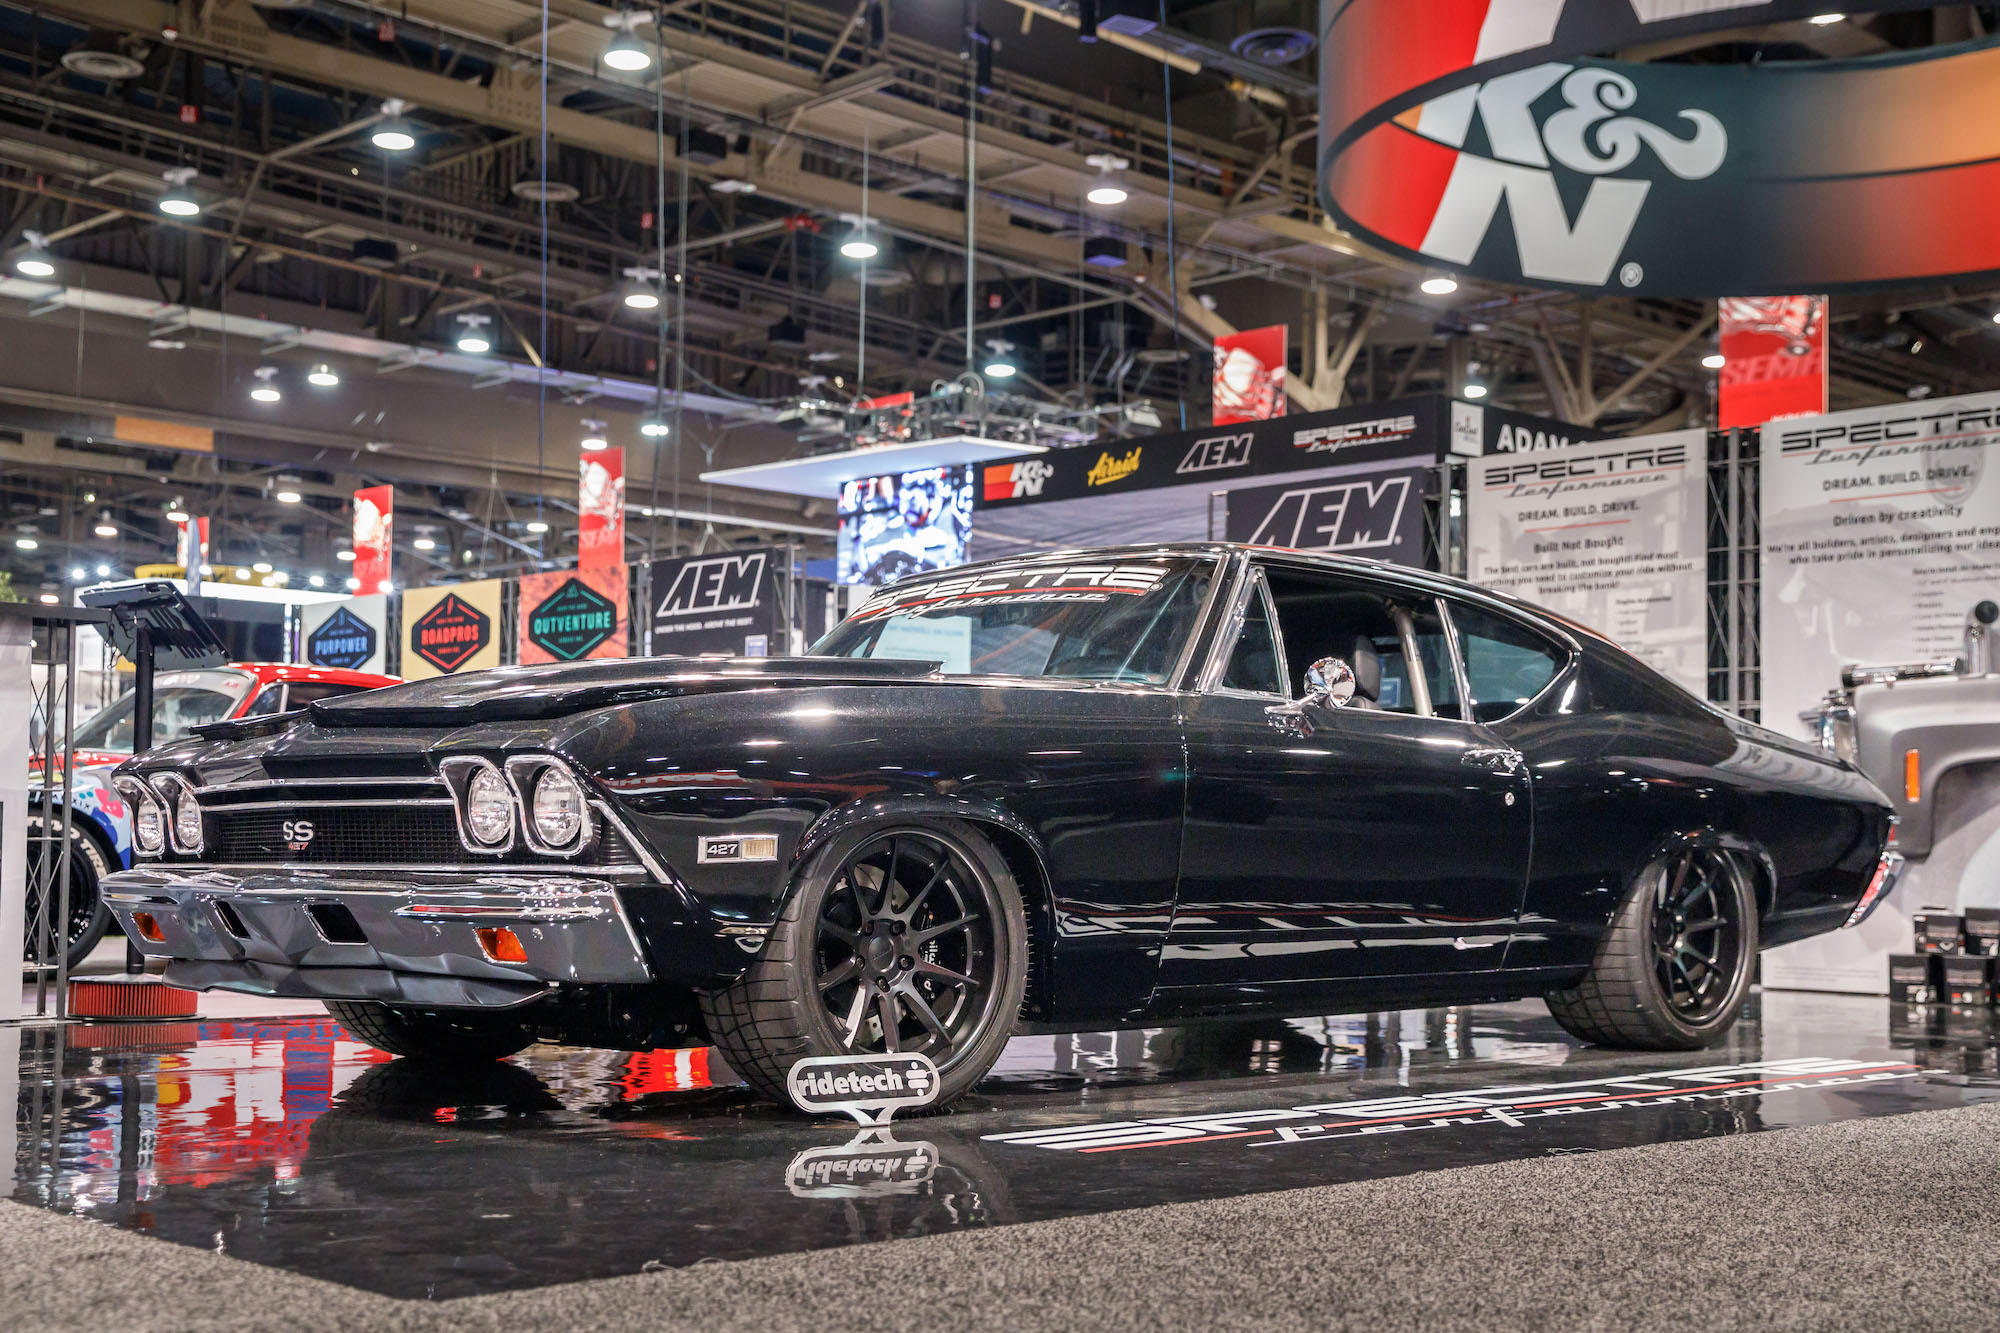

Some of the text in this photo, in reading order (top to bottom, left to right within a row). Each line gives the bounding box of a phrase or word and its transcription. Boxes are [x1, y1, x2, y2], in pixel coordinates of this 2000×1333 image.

[1293, 414, 1415, 446] SPECTRE
[1781, 405, 2000, 452] SPECTR
[1176, 432, 1255, 474] AEM
[1484, 445, 1686, 486] SPECTRE
[1823, 464, 1976, 492] DREAM. BUILD. DRIVE.
[1248, 476, 1412, 553] AEM
[1518, 499, 1641, 523] DREAM. BUILD. DRIVE.
[1833, 503, 1964, 527] Driven by creativity
[1533, 541, 1560, 554] Built
[1584, 536, 1624, 549] Bought
[655, 553, 767, 617] AEM
[858, 566, 1170, 613] SPECTRE
[421, 624, 480, 646] ROADPROS
[533, 610, 611, 635] OUTVENTURE
[282, 820, 314, 842] SS
[288, 842, 309, 850] 427
[707, 843, 738, 855] 427
[796, 1067, 903, 1097] ridetech
[980, 1057, 1907, 1150] SPECTRE
